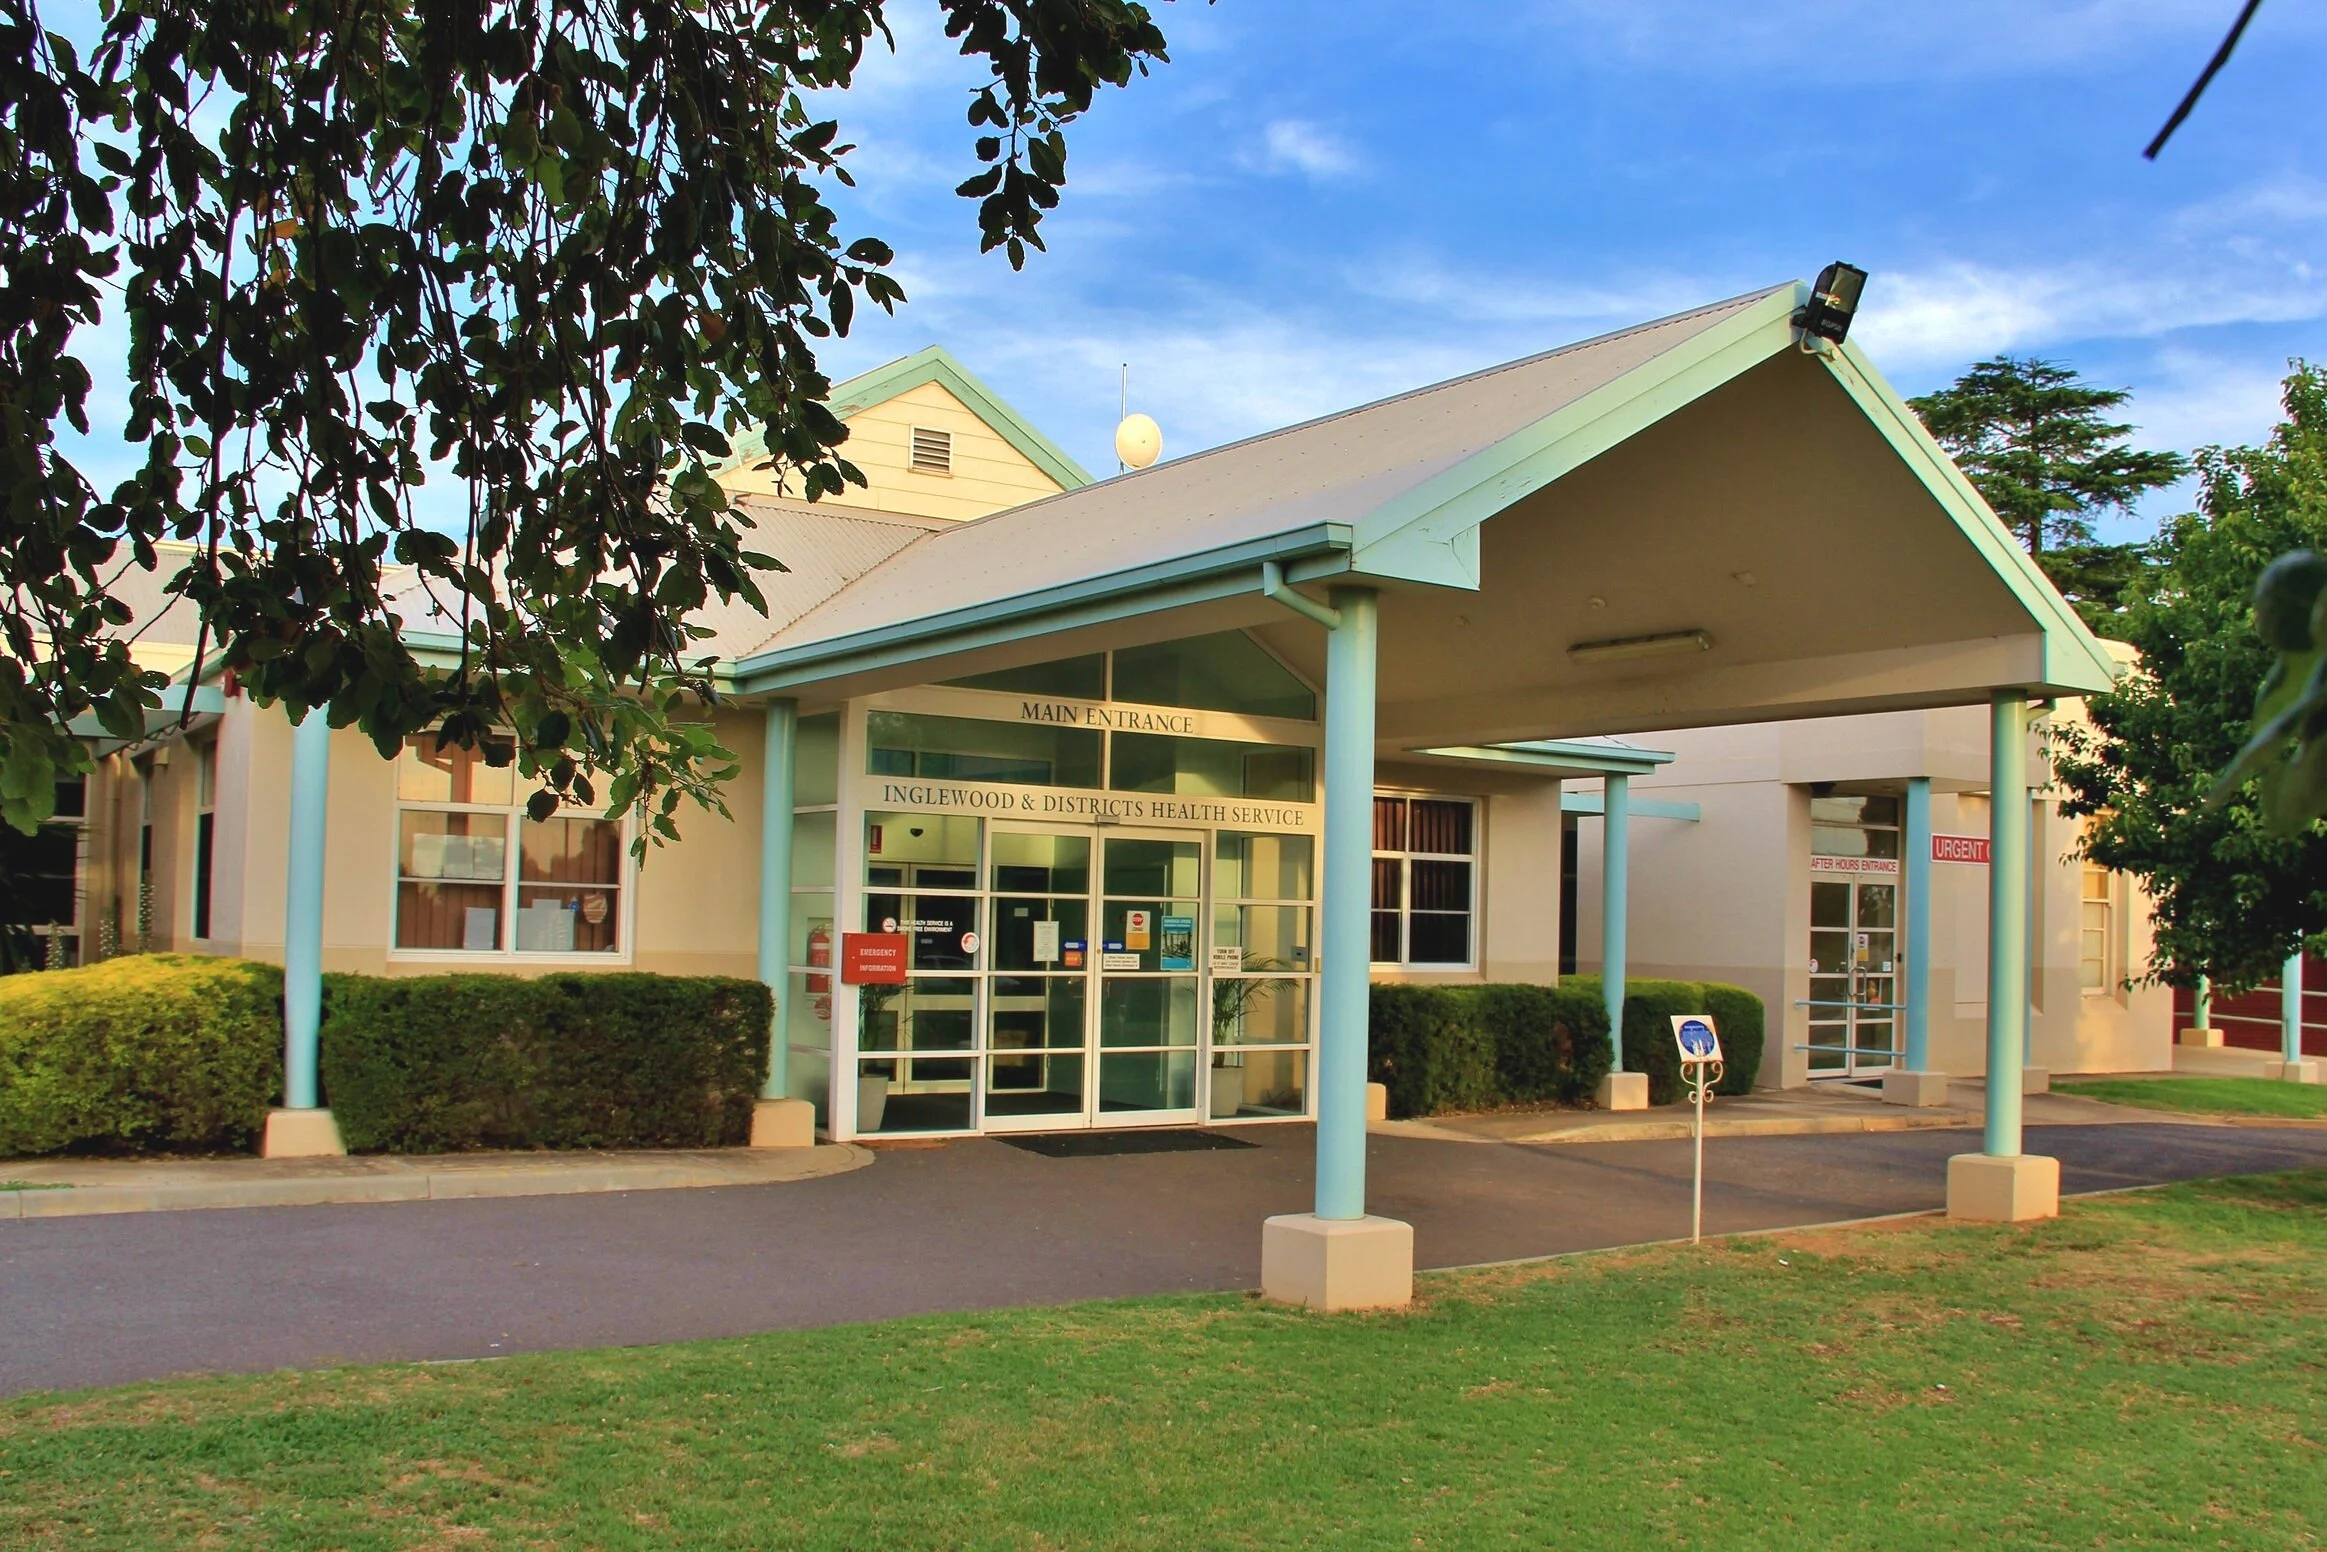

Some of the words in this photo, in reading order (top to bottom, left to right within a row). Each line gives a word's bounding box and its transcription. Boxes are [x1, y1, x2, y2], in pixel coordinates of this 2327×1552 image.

[1020, 701, 1078, 724] MAIN
[1086, 708, 1193, 733] ENTRANCE
[883, 784, 1014, 810] INGLEWOOD
[1022, 794, 1034, 811] &
[1044, 794, 1143, 818] DISTRICTS
[1151, 801, 1226, 822] HEALTH
[1231, 806, 1304, 826] SERVICE
[1936, 839, 1984, 860] URGENT
[1811, 858, 1833, 870] AFTER
[1835, 859, 1859, 871] HOURS
[1861, 860, 1896, 873] ENTRANCE
[860, 948, 897, 956] EMERGENCY
[859, 964, 897, 972] INFORMATION
